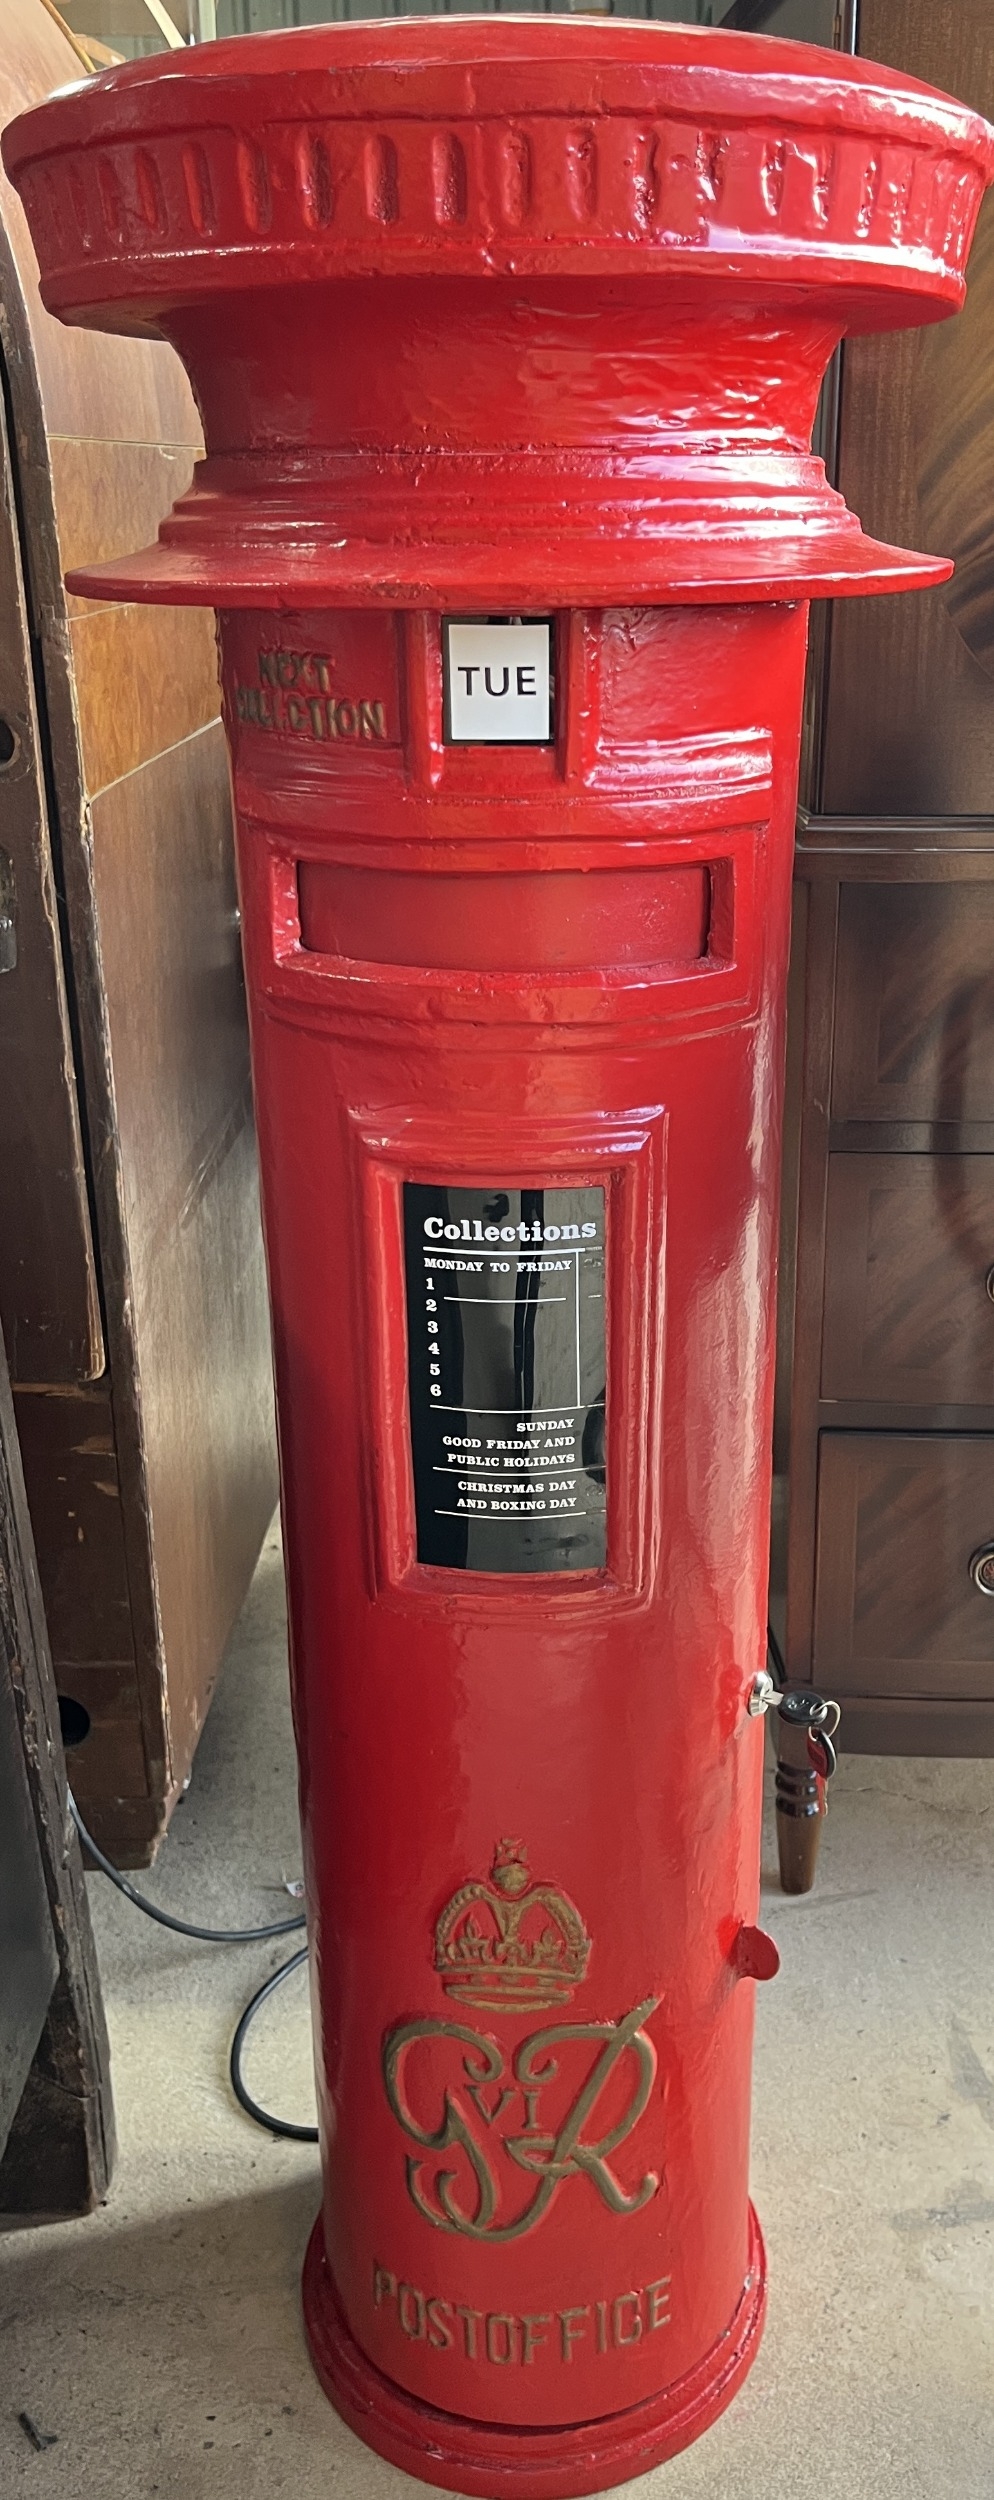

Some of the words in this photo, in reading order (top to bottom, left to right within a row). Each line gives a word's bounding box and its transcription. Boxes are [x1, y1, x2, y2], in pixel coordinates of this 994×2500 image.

[258, 650, 333, 695] NEXT
[457, 666, 537, 697] TUE
[423, 1216, 597, 1242] Collections
[424, 1257, 484, 1272] MONDAY
[490, 1262, 510, 1272] TO
[516, 1260, 573, 1272] FRIDAY
[426, 1277, 435, 1290] 1
[425, 1299, 438, 1312] 2
[427, 1320, 439, 1334] 3
[428, 1342, 440, 1355] 4
[429, 1363, 441, 1376] 5
[430, 1383, 442, 1397] 6
[516, 1418, 575, 1432] SUNDAY
[442, 1435, 482, 1448] GOOD
[486, 1439, 541, 1450] FRIDAY
[544, 1436, 576, 1448] AND
[447, 1453, 500, 1467] PUBLIC
[503, 1453, 576, 1467] HOLIDAYS
[457, 1480, 544, 1493] CHRISTMAS
[549, 1480, 577, 1491] DAY
[456, 1498, 488, 1509] AND
[490, 1500, 546, 1511] BOXING
[549, 1497, 577, 1509] DAY
